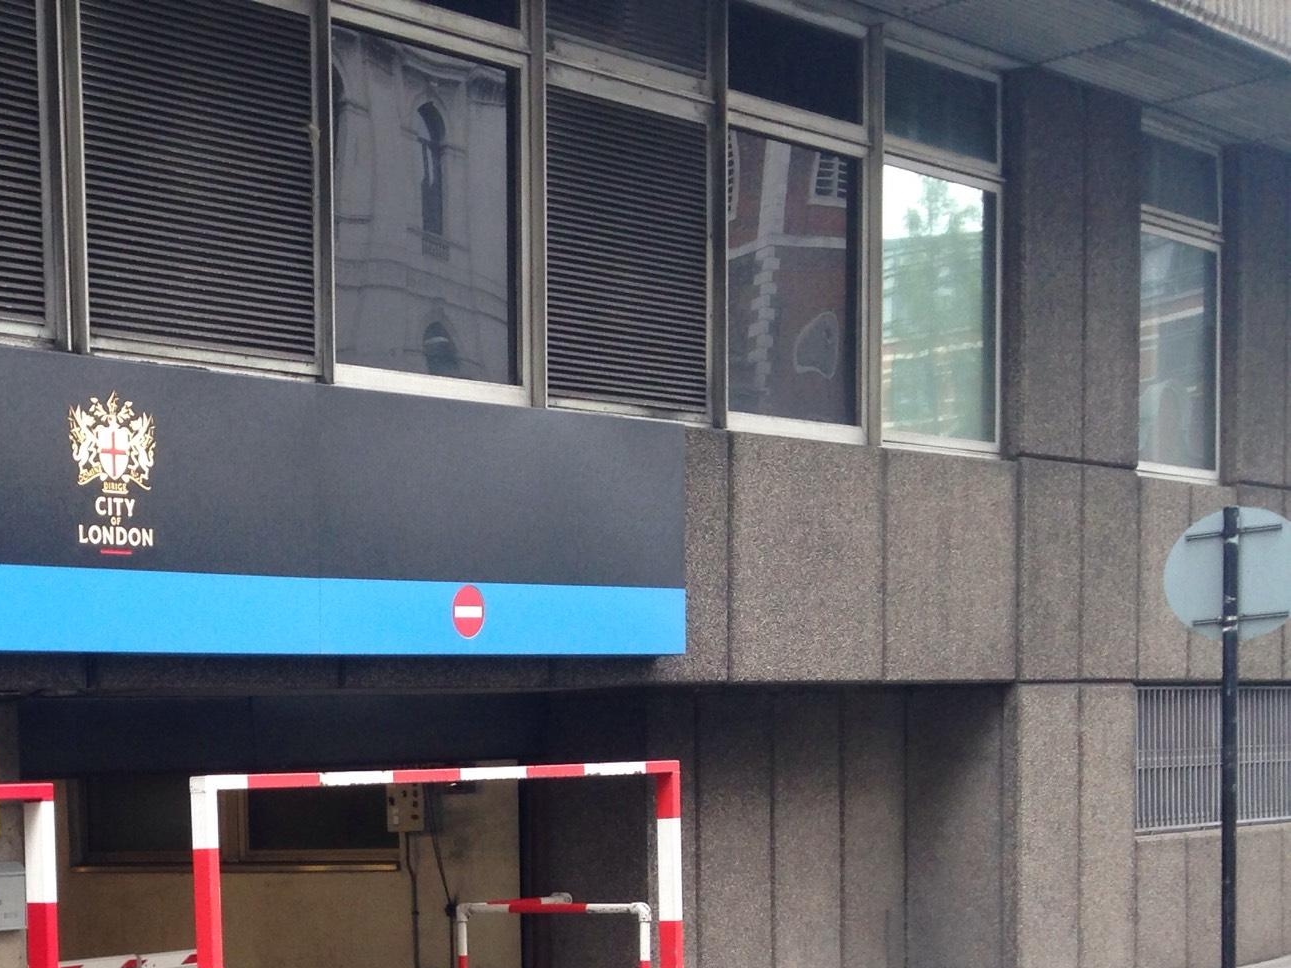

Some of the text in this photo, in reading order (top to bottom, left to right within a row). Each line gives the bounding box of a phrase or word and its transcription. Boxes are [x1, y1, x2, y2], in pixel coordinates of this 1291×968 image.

[95, 496, 135, 517] CITY
[110, 516, 122, 526] OF
[78, 524, 154, 547] LONDON
